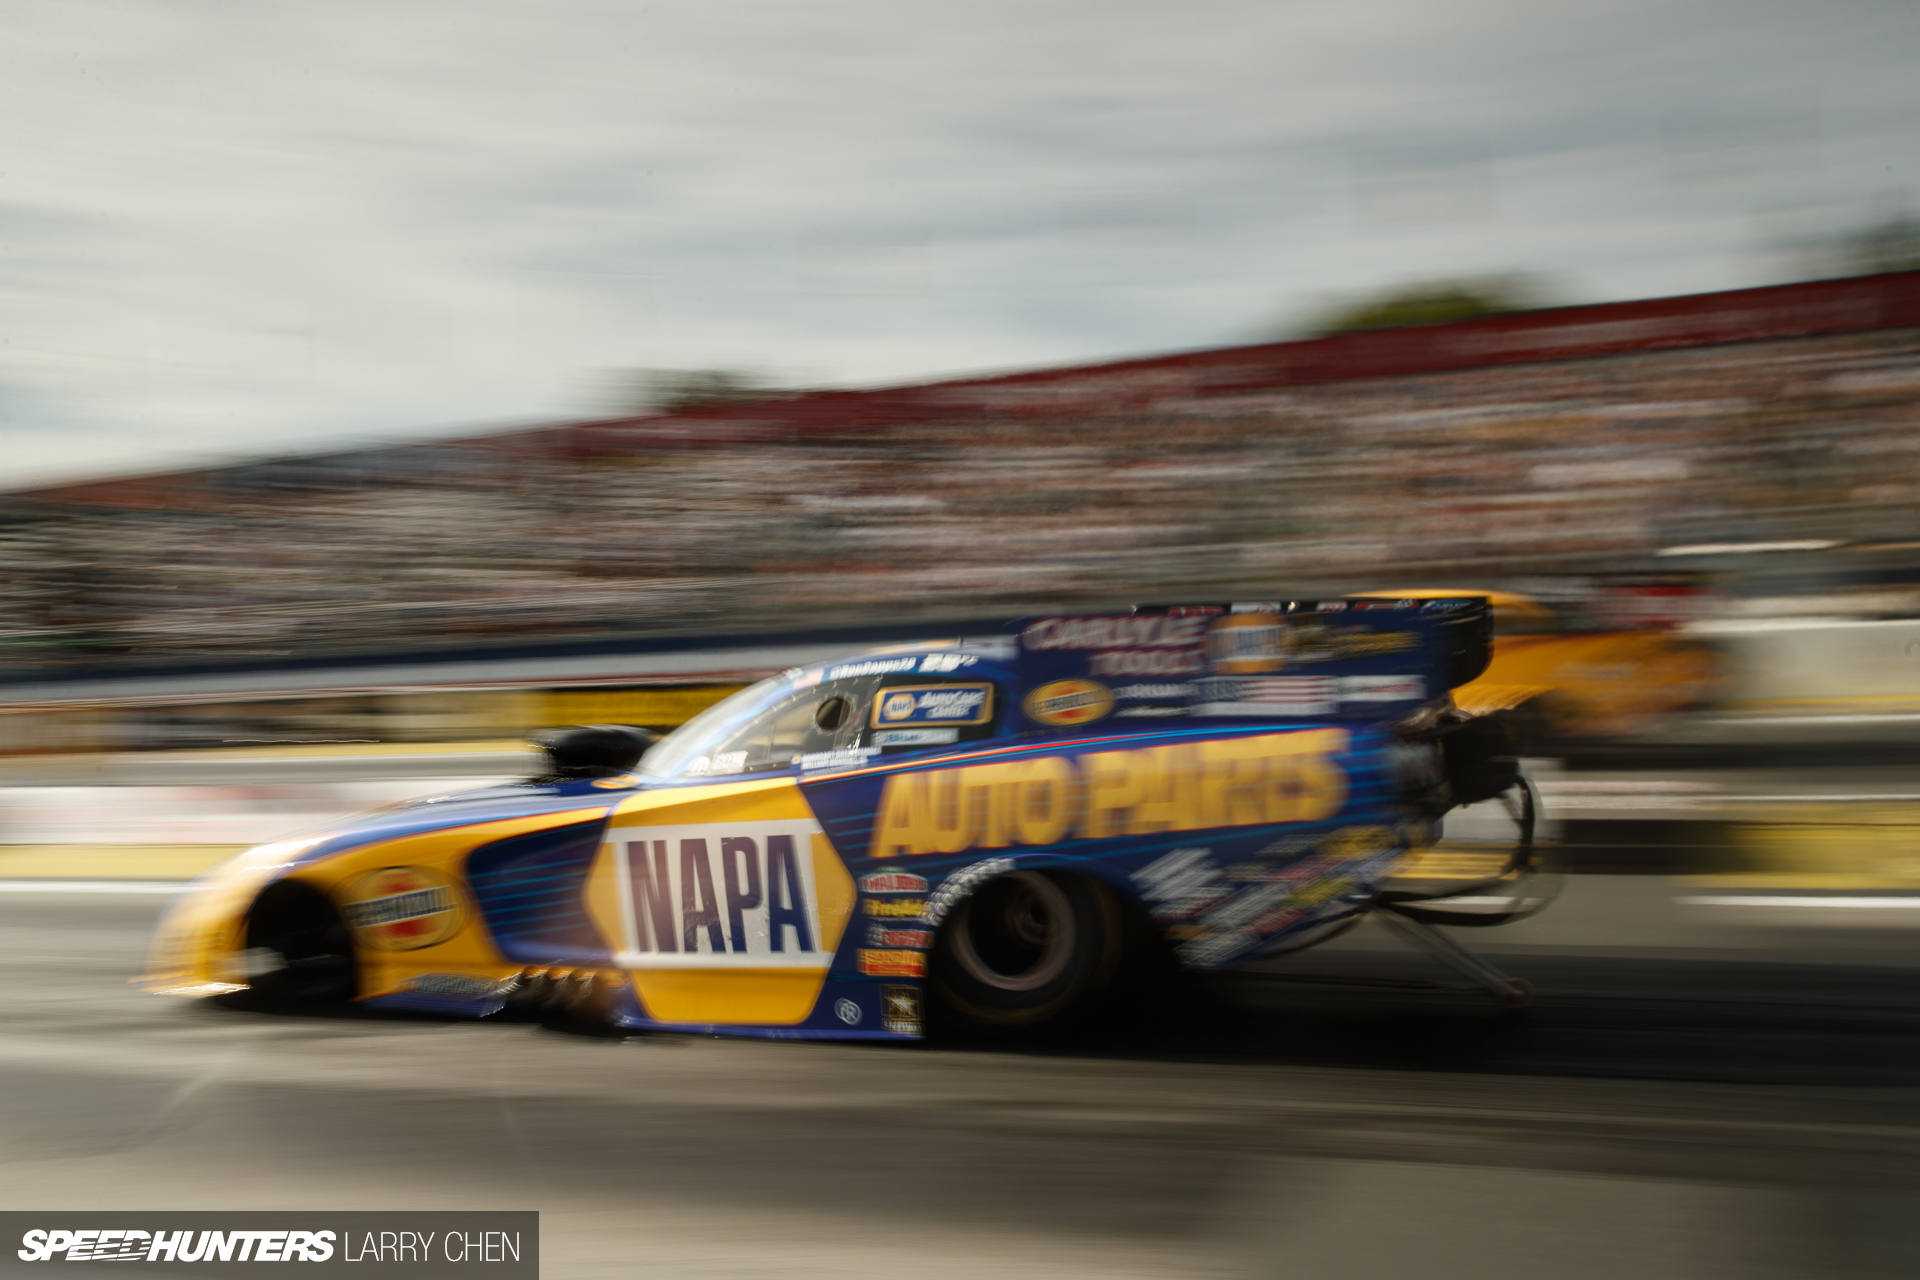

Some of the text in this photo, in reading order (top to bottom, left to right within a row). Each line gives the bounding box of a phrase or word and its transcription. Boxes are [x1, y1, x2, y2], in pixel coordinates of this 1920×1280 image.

[869, 728, 1351, 858] AUTO PARTS
[627, 834, 816, 953] NAPA
